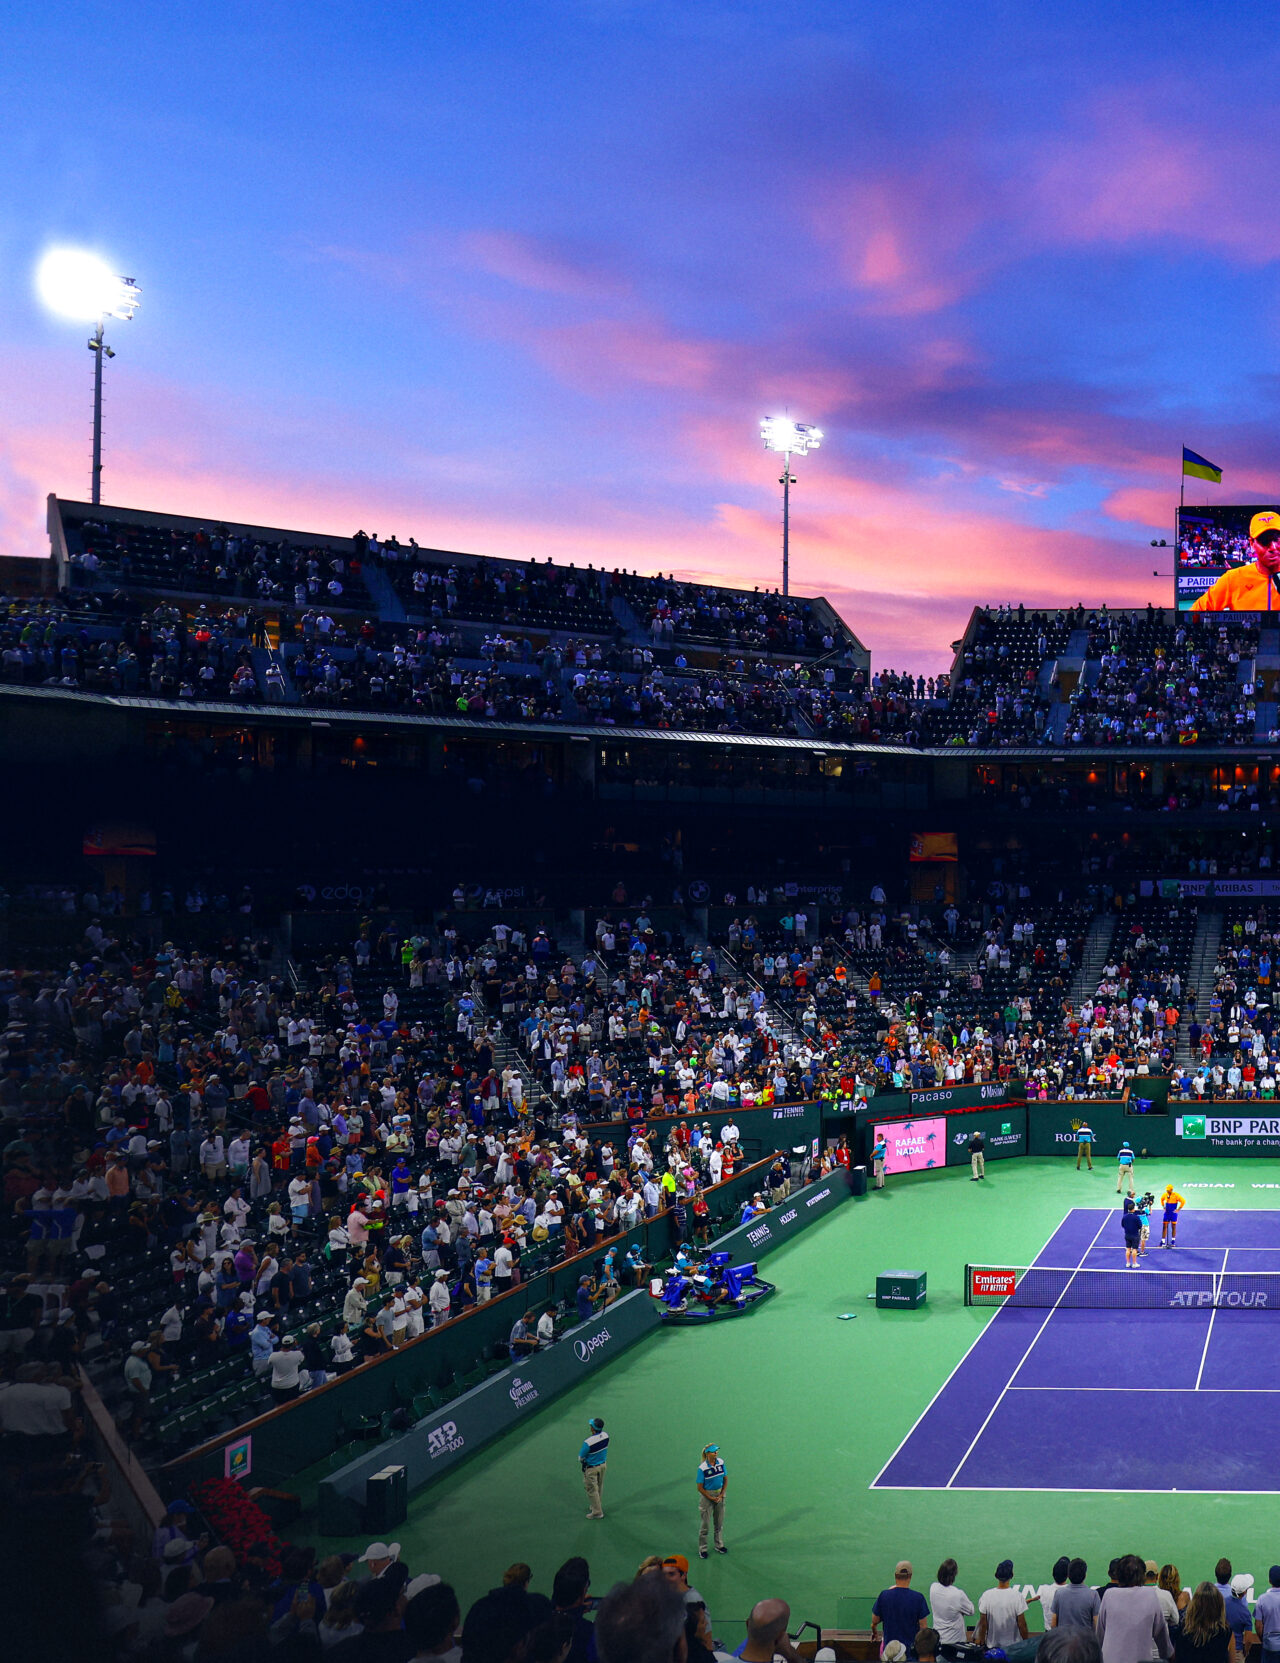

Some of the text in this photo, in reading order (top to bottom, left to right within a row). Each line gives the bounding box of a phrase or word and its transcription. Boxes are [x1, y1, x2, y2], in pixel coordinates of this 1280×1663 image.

[1213, 884, 1254, 895] ARIBAS
[911, 1091, 952, 1103] Pacaso
[784, 1105, 805, 1114] TENNIS
[1210, 1120, 1243, 1134] BNP
[895, 1136, 926, 1148] RAFAEL
[1055, 1133, 1097, 1143] ROLX
[1210, 1138, 1223, 1146] The
[1225, 1138, 1243, 1146] bank
[1243, 1139, 1254, 1148] for
[895, 1146, 925, 1157] NADAL
[778, 1208, 798, 1226] HOLOGIC
[746, 1223, 771, 1244] TENNIS
[975, 1275, 1013, 1285] Emirates
[989, 1284, 1008, 1292] BETTER
[1167, 1291, 1268, 1307] ATP TOUR
[586, 1326, 611, 1355] pepsi
[510, 1380, 534, 1401] Corona
[427, 1420, 457, 1454] ATP
[446, 1435, 465, 1453] 1000
